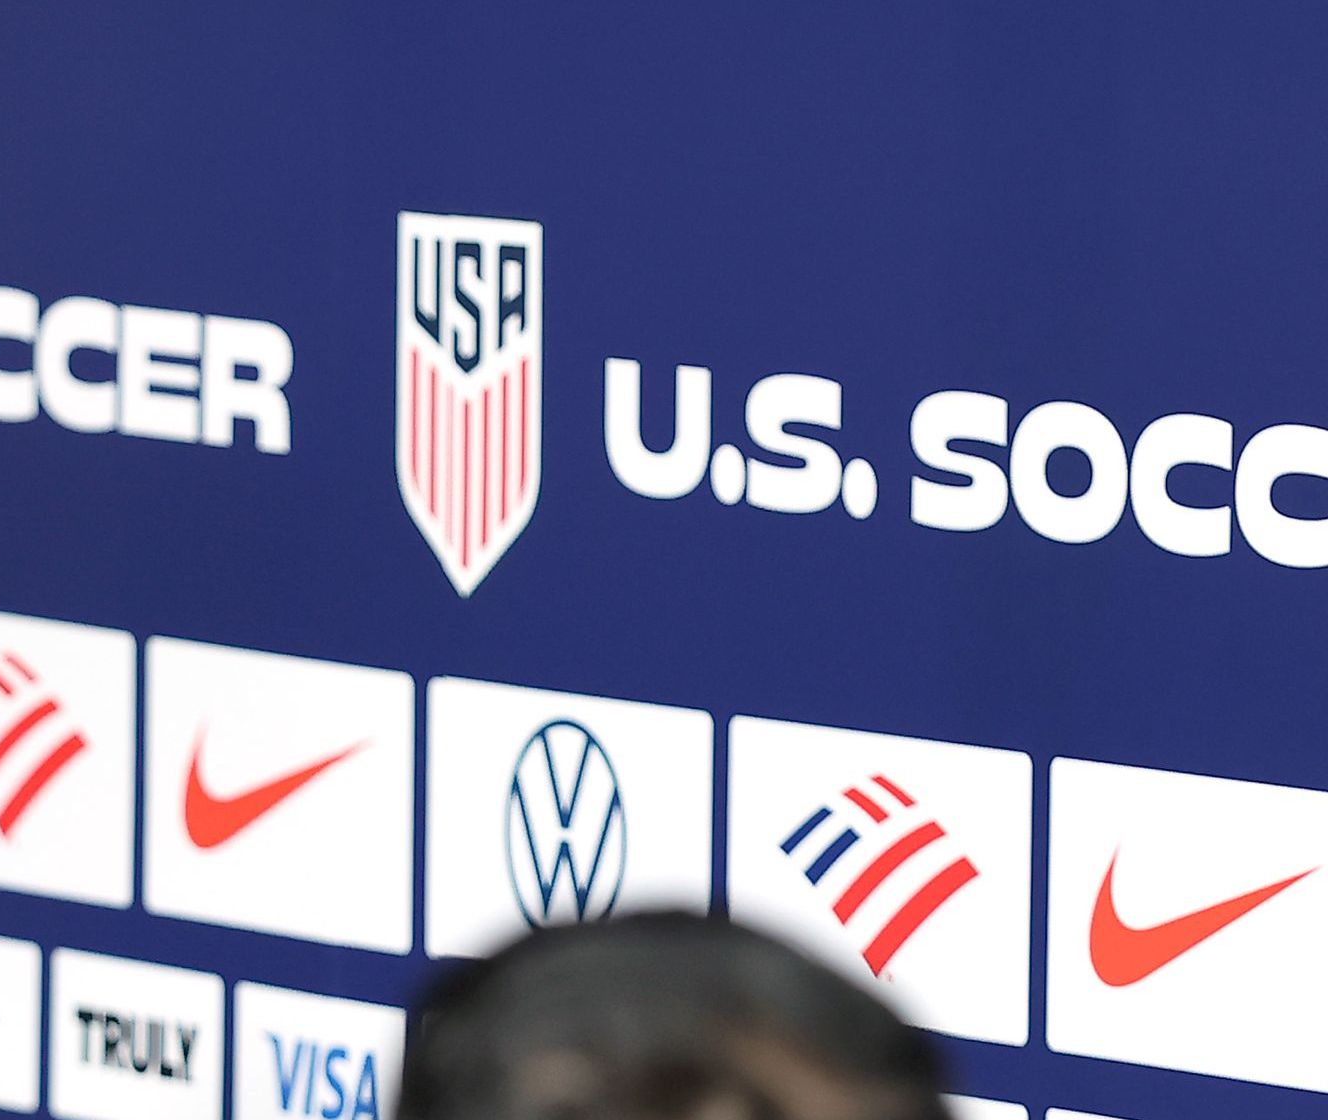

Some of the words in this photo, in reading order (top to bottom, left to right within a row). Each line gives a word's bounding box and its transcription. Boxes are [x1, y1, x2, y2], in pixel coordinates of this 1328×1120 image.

[412, 236, 527, 373] USA
[604, 356, 879, 520] U.S.
[75, 1007, 199, 1083] TRULY
